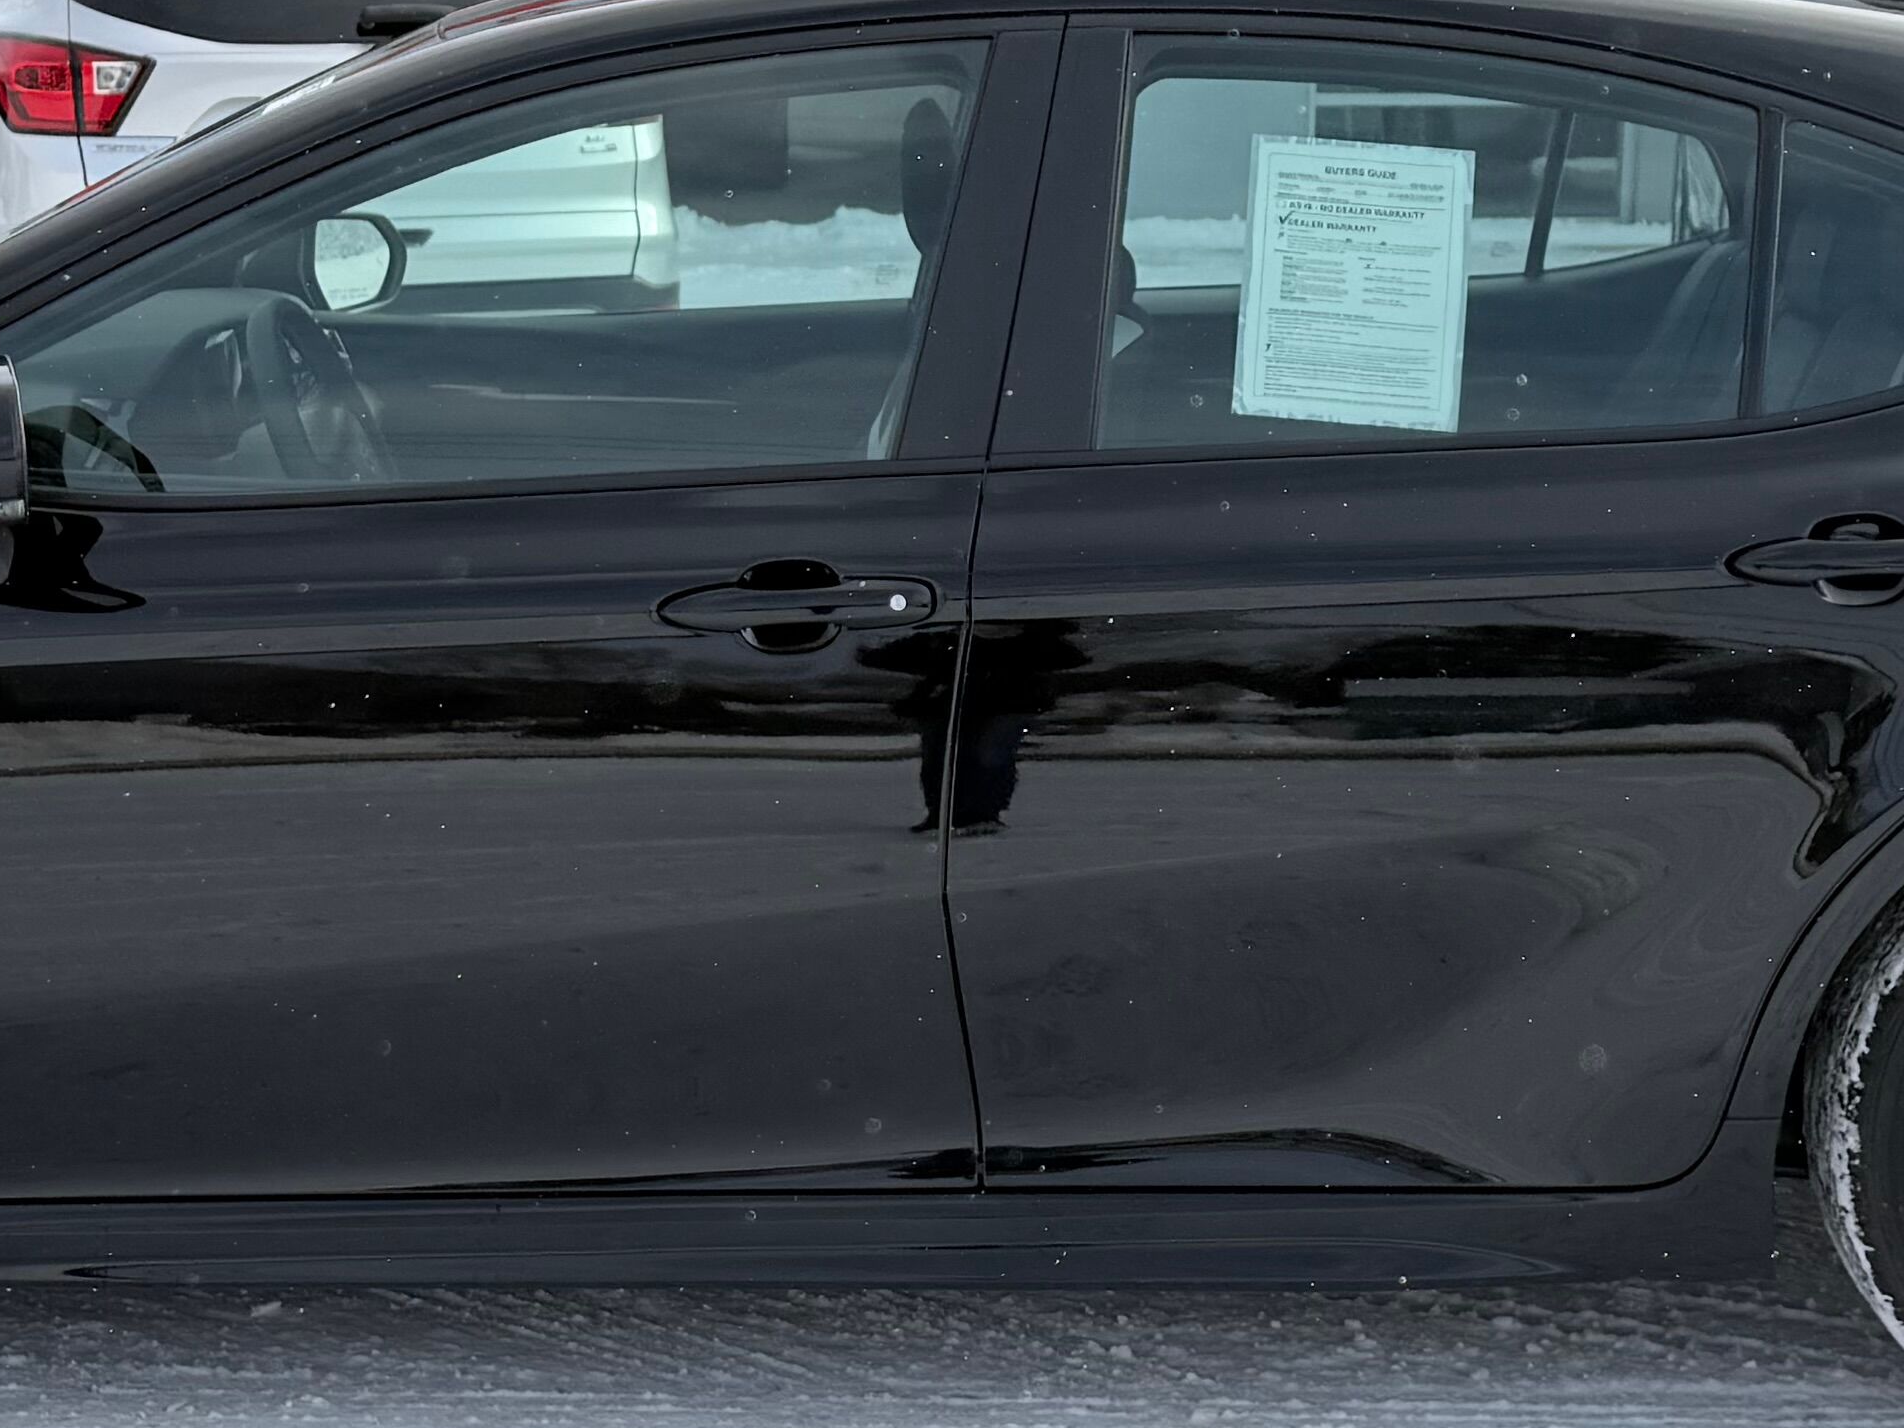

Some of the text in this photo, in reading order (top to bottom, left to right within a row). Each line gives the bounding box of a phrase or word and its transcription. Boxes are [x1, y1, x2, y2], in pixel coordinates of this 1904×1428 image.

[1324, 165, 1365, 177] BUYERS
[1367, 168, 1397, 180] GUIDE
[1336, 205, 1372, 216] DEALER
[1374, 209, 1425, 220] WARRANTY
[1327, 222, 1377, 233] WARRANTY
